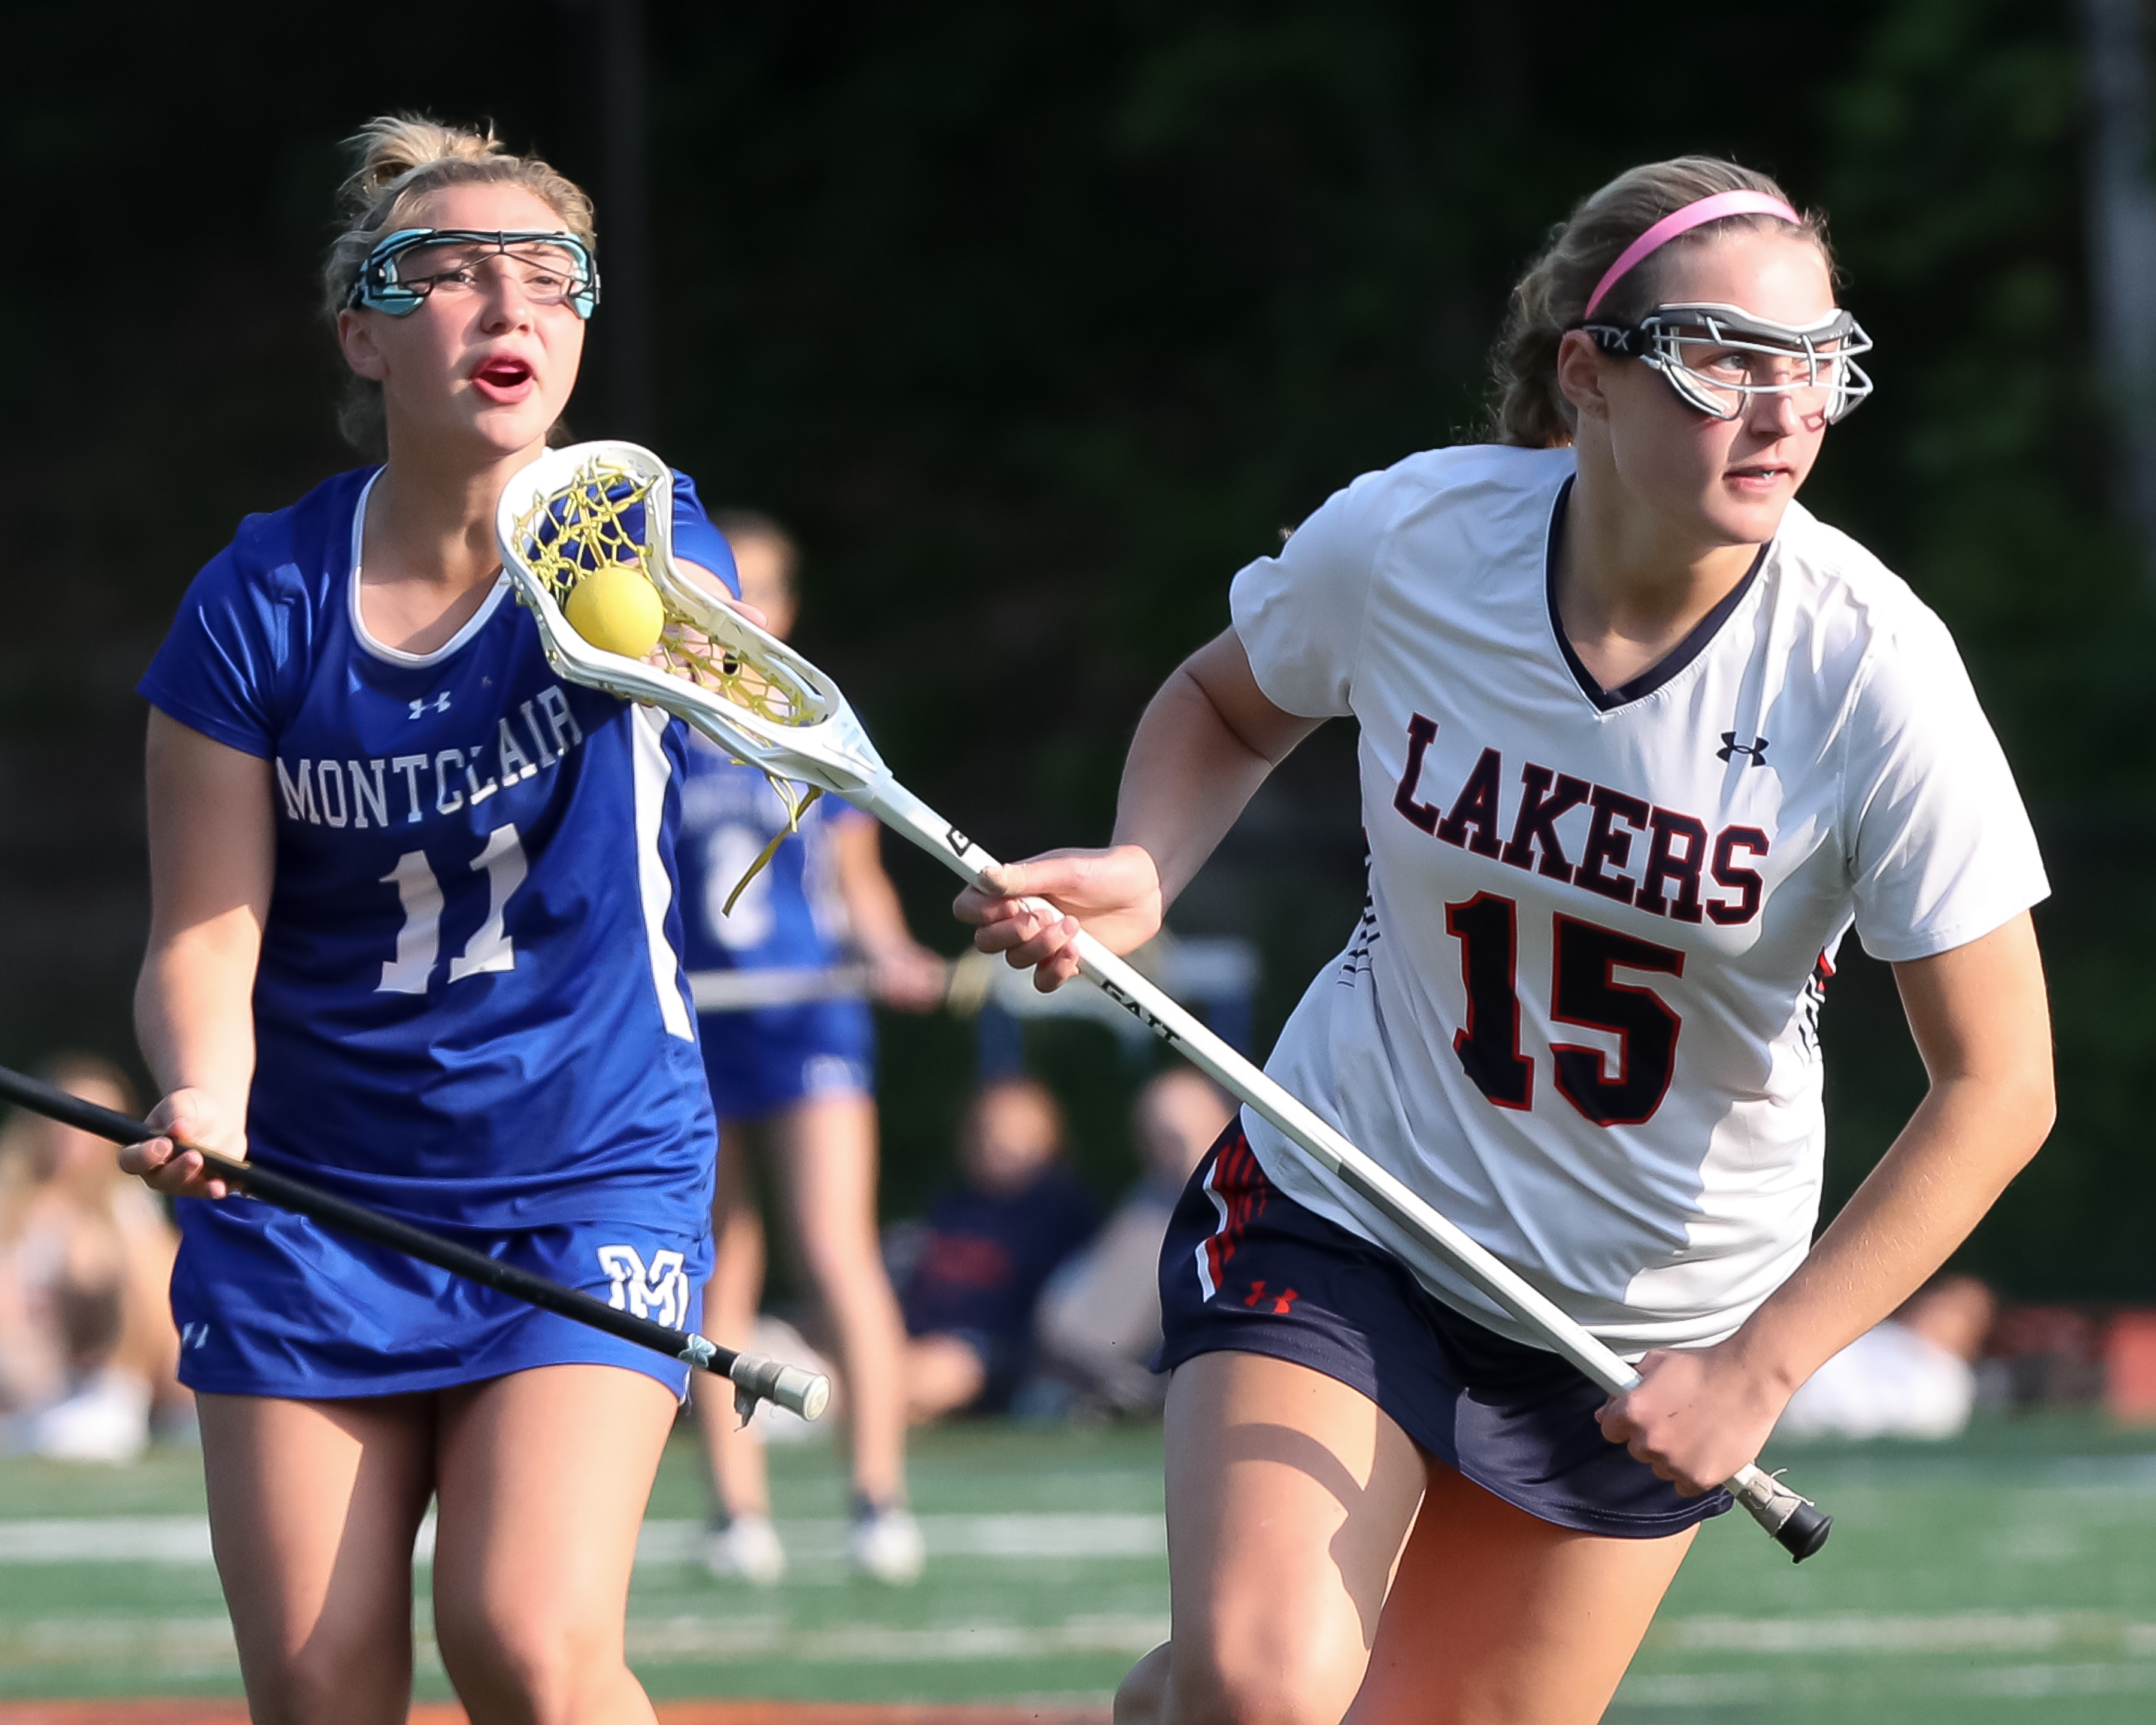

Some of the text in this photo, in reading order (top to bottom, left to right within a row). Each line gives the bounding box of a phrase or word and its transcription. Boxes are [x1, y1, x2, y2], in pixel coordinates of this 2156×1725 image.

[276, 685, 582, 828] MONTCLAIR
[1393, 712, 1770, 925] LAKERS
[373, 822, 529, 994] 11
[1444, 890, 1686, 1128] 15
